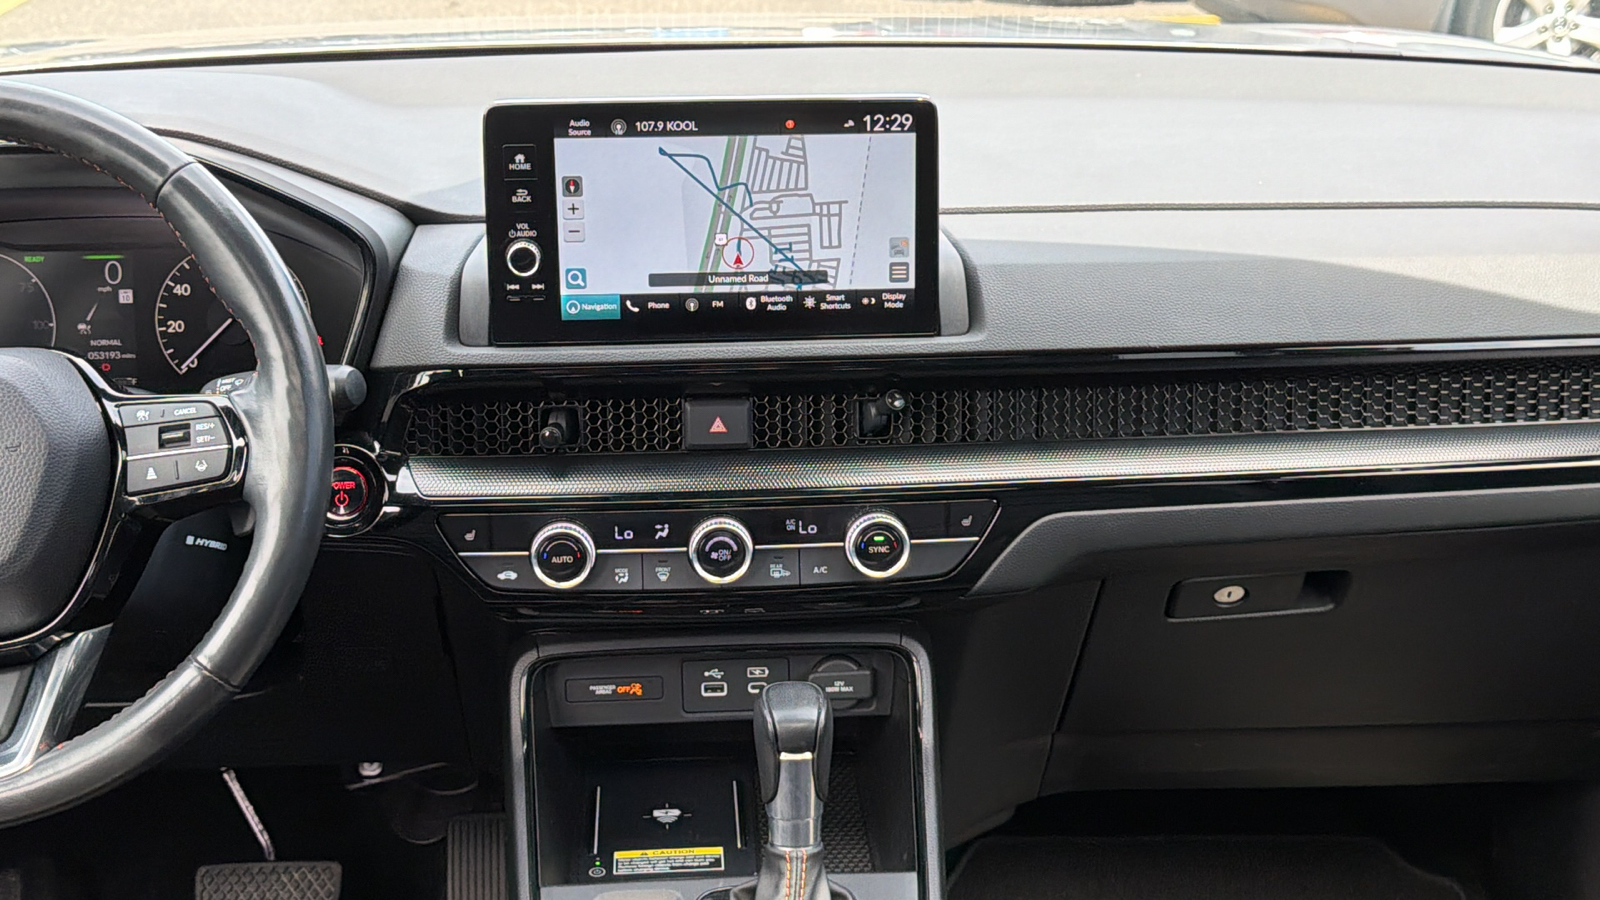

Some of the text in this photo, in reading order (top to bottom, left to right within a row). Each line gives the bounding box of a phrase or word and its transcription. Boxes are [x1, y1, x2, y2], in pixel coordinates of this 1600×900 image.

[569, 119, 590, 128] Audio
[635, 120, 698, 132] 107.9 KOOL
[863, 114, 913, 131] 12:29
[568, 128, 592, 137] Source
[508, 162, 532, 171] HOME
[511, 195, 532, 203] BACK
[516, 222, 530, 230] VOL
[516, 229, 537, 238] AUDIO
[104, 260, 123, 285] 0
[708, 273, 770, 284] Unnamed Road
[173, 284, 191, 296] 40
[122, 294, 131, 302] 10
[760, 295, 793, 303] Bluetooth
[826, 294, 845, 302] Smart
[882, 292, 906, 302] Display
[582, 303, 617, 311] Navigation
[648, 302, 670, 310] Phone
[712, 300, 724, 308] FM
[767, 303, 787, 311] Audio
[820, 302, 851, 310] Shortcuts
[885, 301, 904, 309] Mode
[167, 320, 185, 333] 20
[90, 339, 123, 347] NORMAL
[88, 351, 121, 360] 053193
[174, 407, 197, 416] CANCEL
[196, 423, 215, 431] RES/+
[798, 520, 817, 534] Lo
[614, 525, 634, 540] Lo
[195, 537, 228, 551] HYBRID
[868, 545, 890, 554] SYNC
[551, 555, 574, 564] AUTO
[813, 566, 828, 574] A/C
[617, 686, 631, 694] OFF
[840, 685, 854, 693] MAX
